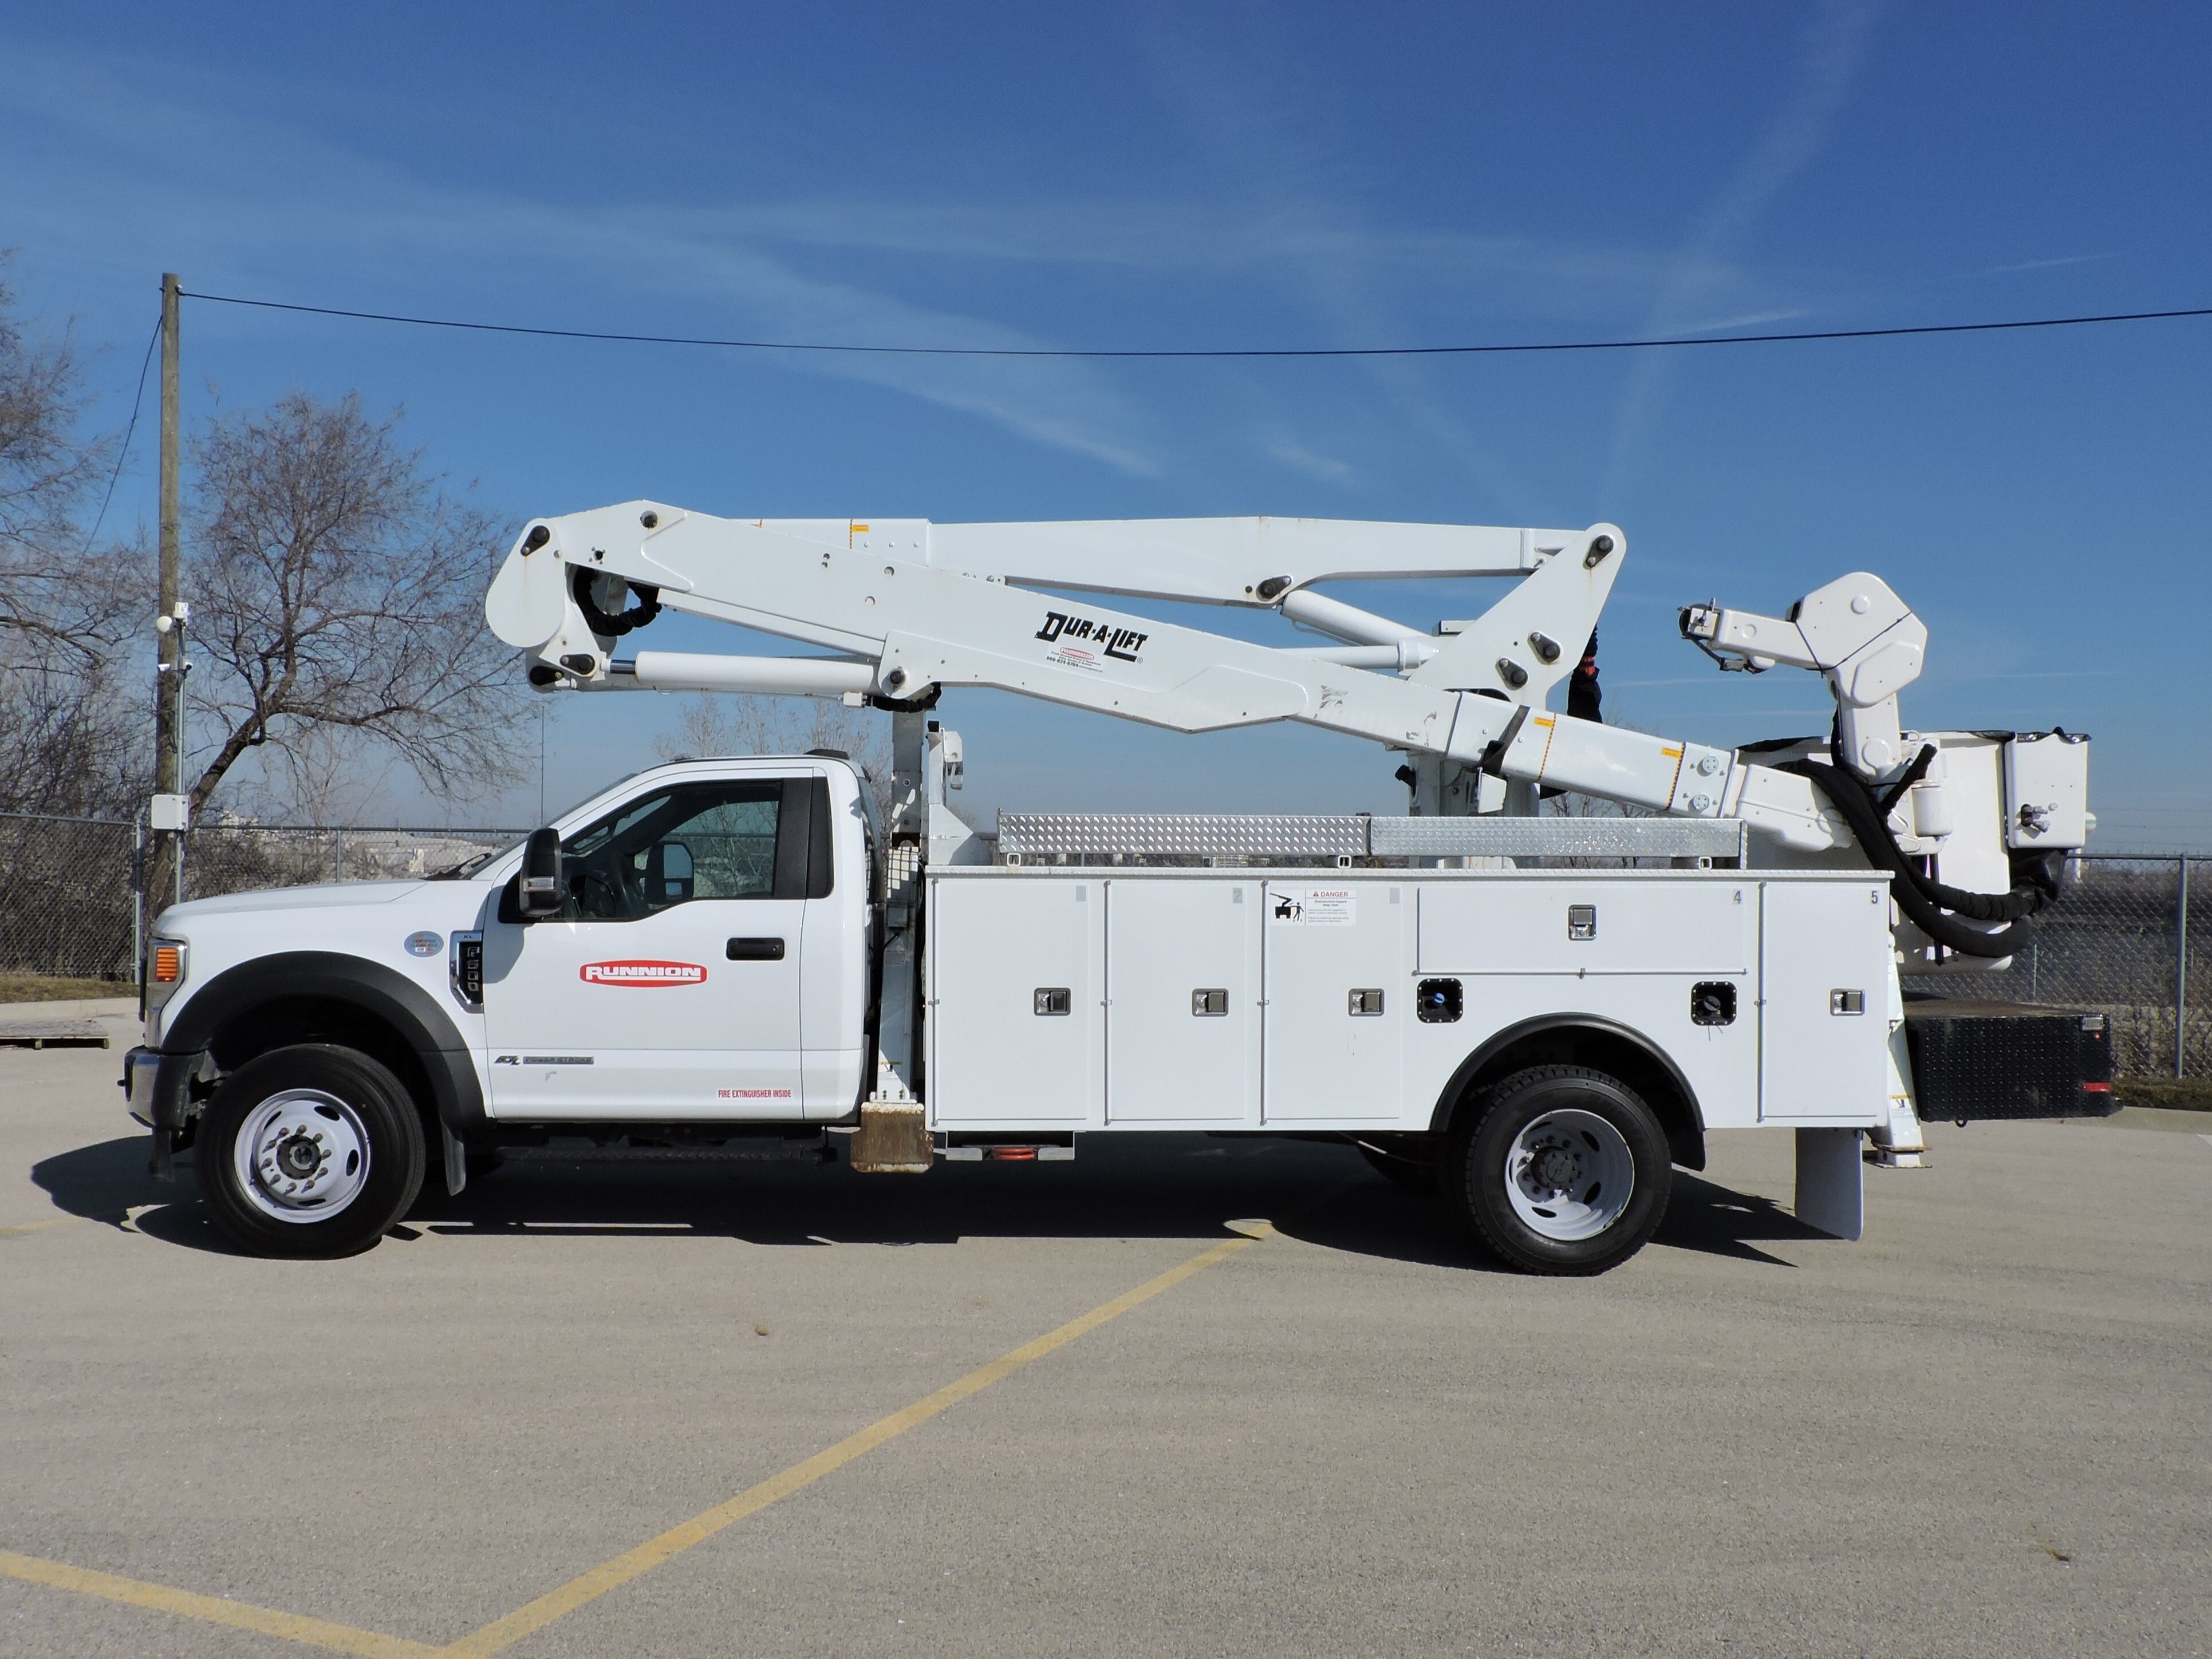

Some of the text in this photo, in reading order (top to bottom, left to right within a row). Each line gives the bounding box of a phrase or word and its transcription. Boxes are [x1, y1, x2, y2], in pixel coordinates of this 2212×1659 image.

[1734, 891, 1741, 904] 4
[1871, 891, 1878, 904] 5
[586, 966, 701, 981] RUNNION
[718, 1089, 791, 1098] FIRE EXTINGUISHER INSIDE
